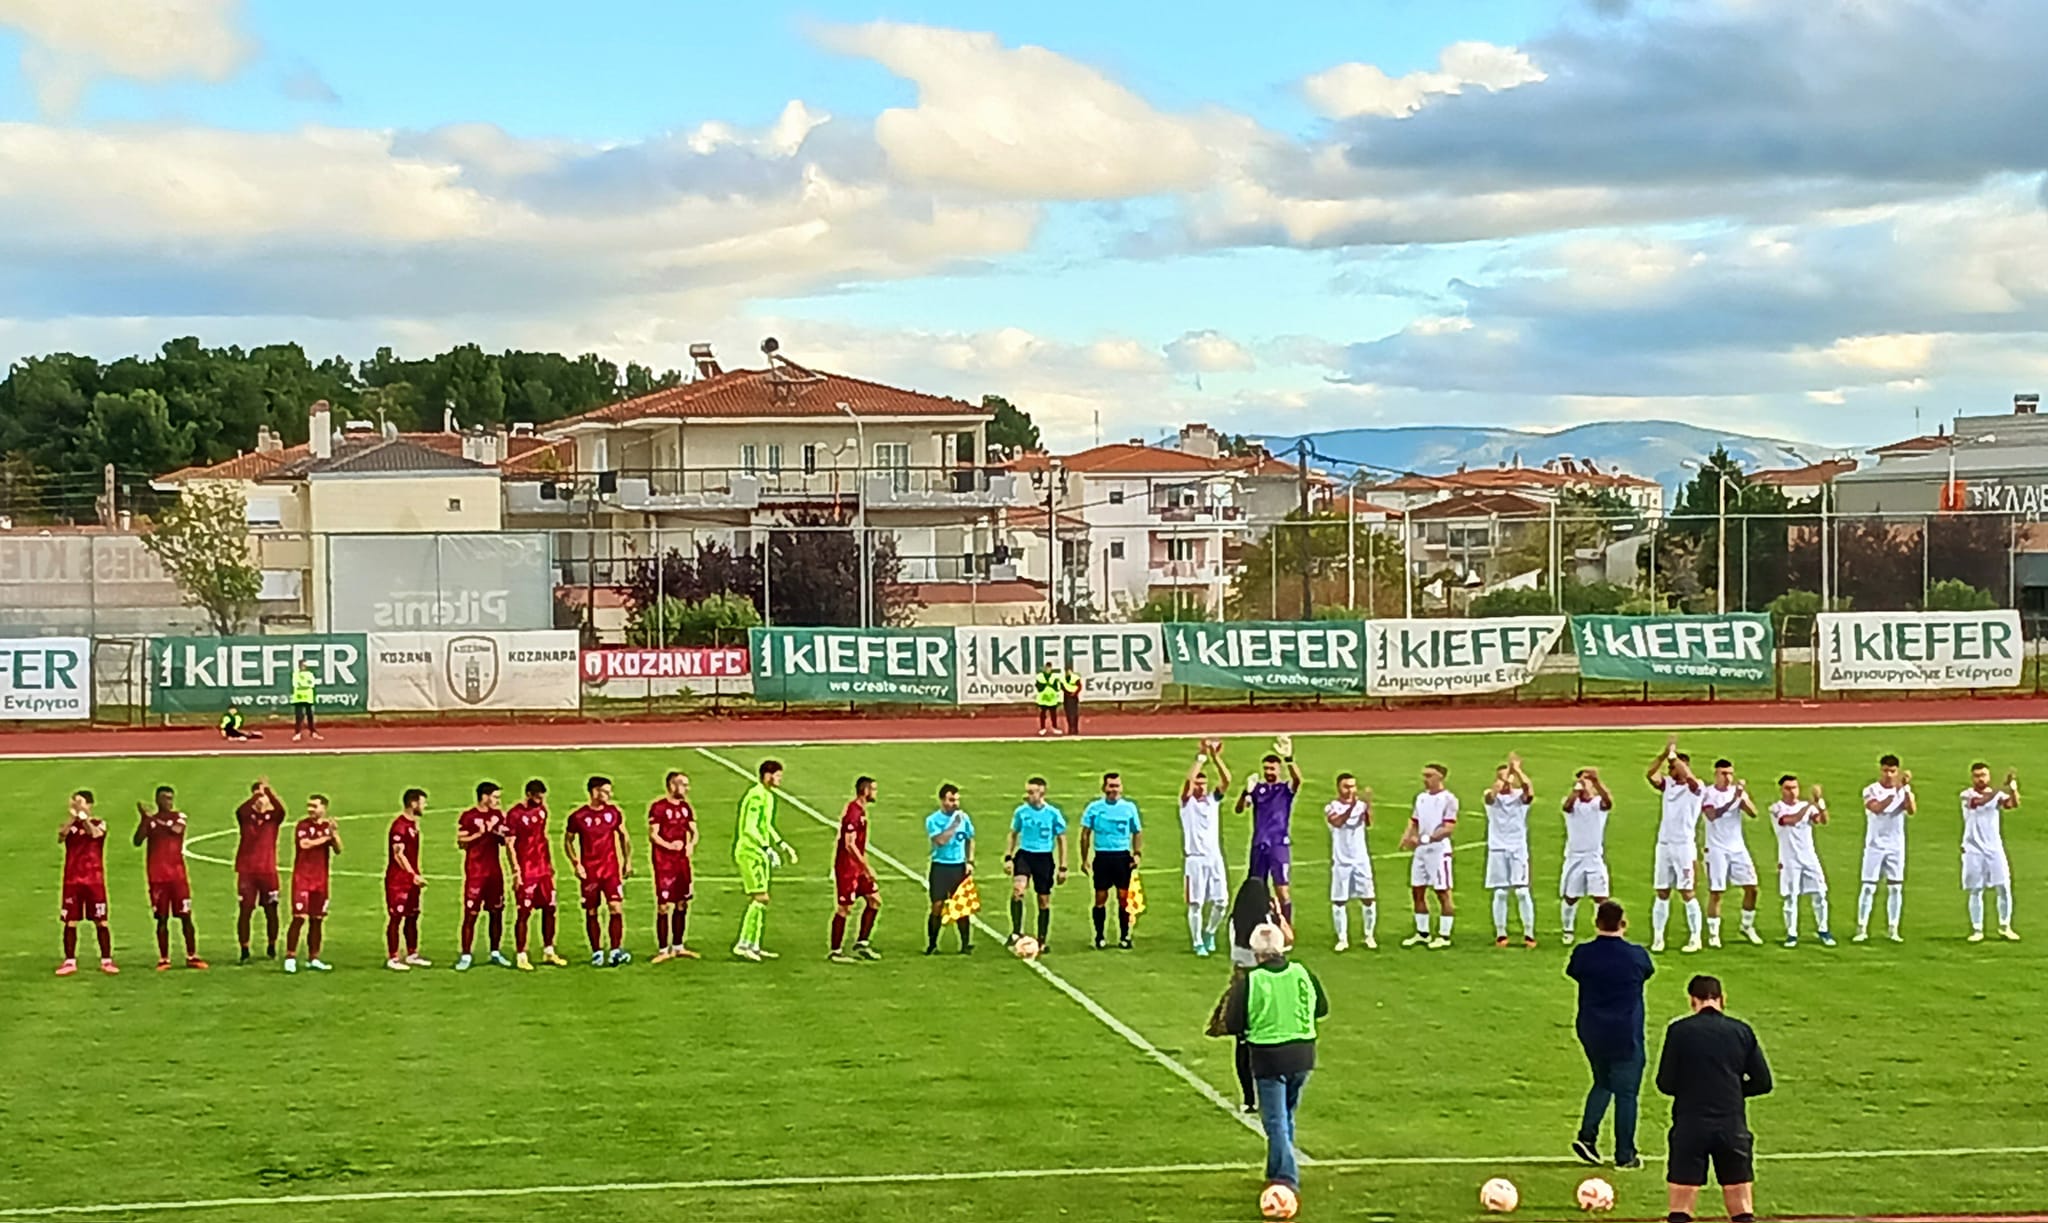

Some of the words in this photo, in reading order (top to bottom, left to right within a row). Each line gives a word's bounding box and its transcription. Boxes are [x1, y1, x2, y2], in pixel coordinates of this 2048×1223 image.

[607, 652, 703, 676] KOZANI
[710, 652, 741, 674] FC
[1653, 663, 1672, 674] we
[1675, 663, 1717, 676] create
[1720, 667, 1764, 680] energy
[829, 682, 849, 692] we
[853, 681, 897, 693] create
[899, 684, 949, 697] energy
[968, 682, 1034, 696] Δημιουρ
[1243, 674, 1263, 684] we
[1267, 673, 1308, 685] create
[1309, 676, 1359, 689] energy
[230, 695, 253, 706] we
[256, 694, 293, 706] crea
[315, 693, 359, 706] nergy
